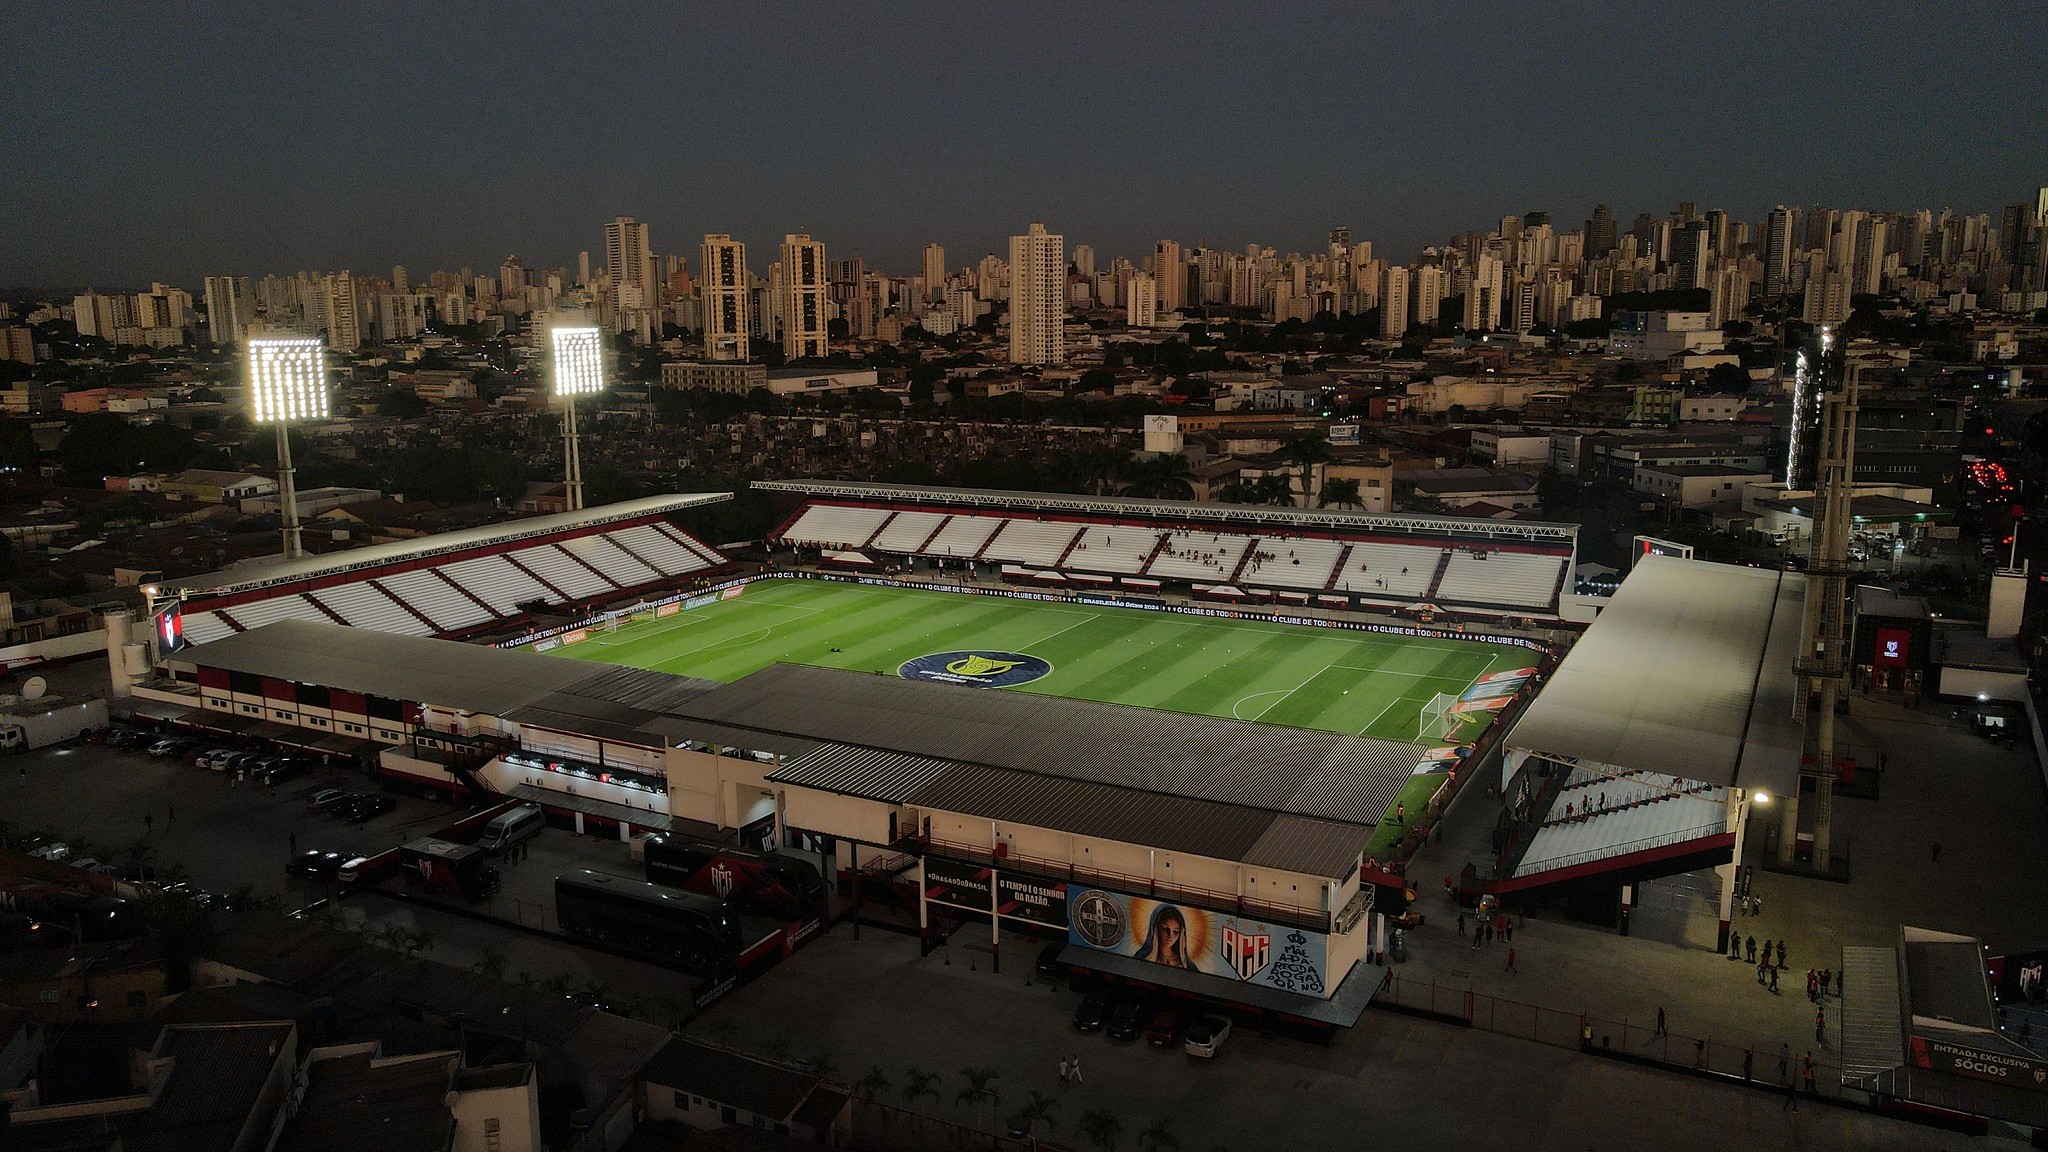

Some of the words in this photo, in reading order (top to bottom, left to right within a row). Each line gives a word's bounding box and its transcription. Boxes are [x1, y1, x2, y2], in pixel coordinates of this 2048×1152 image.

[1216, 610, 1238, 618] TODOS
[515, 636, 534, 645] CLUBE
[542, 627, 561, 638] TODOS
[1379, 625, 1404, 634] CLUBE
[1416, 629, 1442, 638] TODOS
[1487, 635, 1513, 645] CLUBE
[1525, 639, 1542, 651] TODOS
[1006, 881, 1027, 892] TEMPO
[1028, 882, 1032, 893] É
[1033, 885, 1038, 894] O
[1038, 888, 1065, 900] SENHOR
[1015, 892, 1025, 901] DA
[1025, 893, 1050, 907] RAZÃO.
[1934, 1044, 1979, 1059] ENTRADA
[1980, 1053, 2030, 1069] EXCLUSIVA
[1954, 1057, 2007, 1077] SÓCIOS
